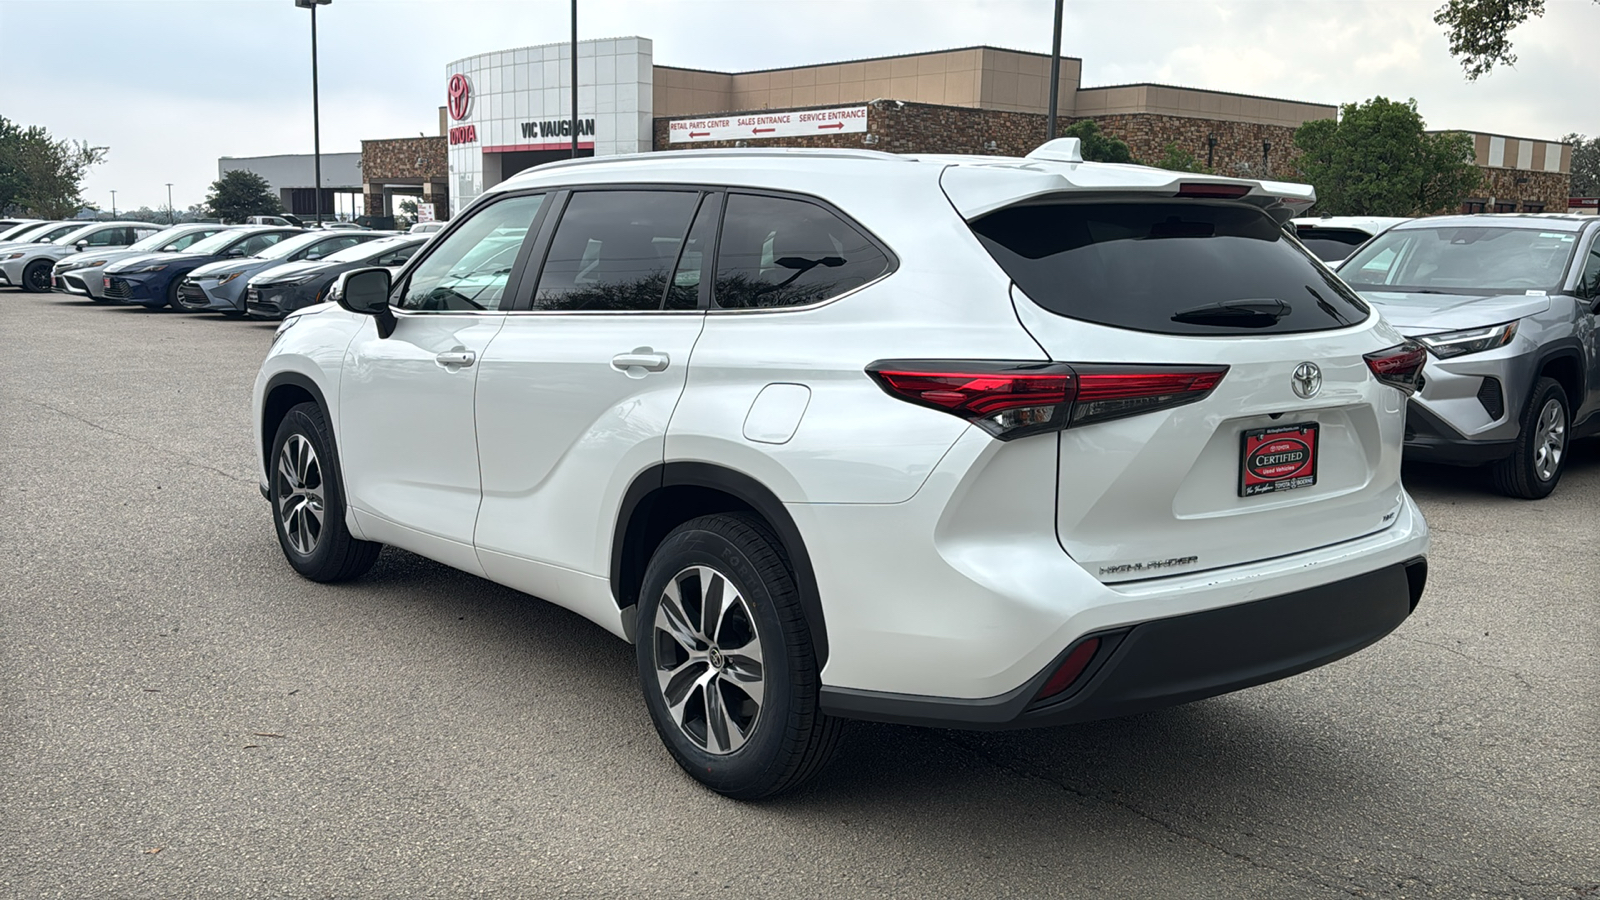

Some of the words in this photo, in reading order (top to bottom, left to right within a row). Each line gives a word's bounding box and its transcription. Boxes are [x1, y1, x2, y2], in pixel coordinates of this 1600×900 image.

[737, 118, 756, 127] SALES
[757, 115, 791, 125] ENTRANCE
[799, 112, 826, 122] SERVICE
[827, 109, 866, 120] ENTRANCE
[521, 122, 538, 139] VIC
[670, 122, 688, 131] RETAIL
[688, 121, 706, 129] PARTS
[707, 119, 730, 128] CENTER
[449, 125, 476, 145] TOYOTA
[1256, 452, 1303, 466] CERTIFIED
